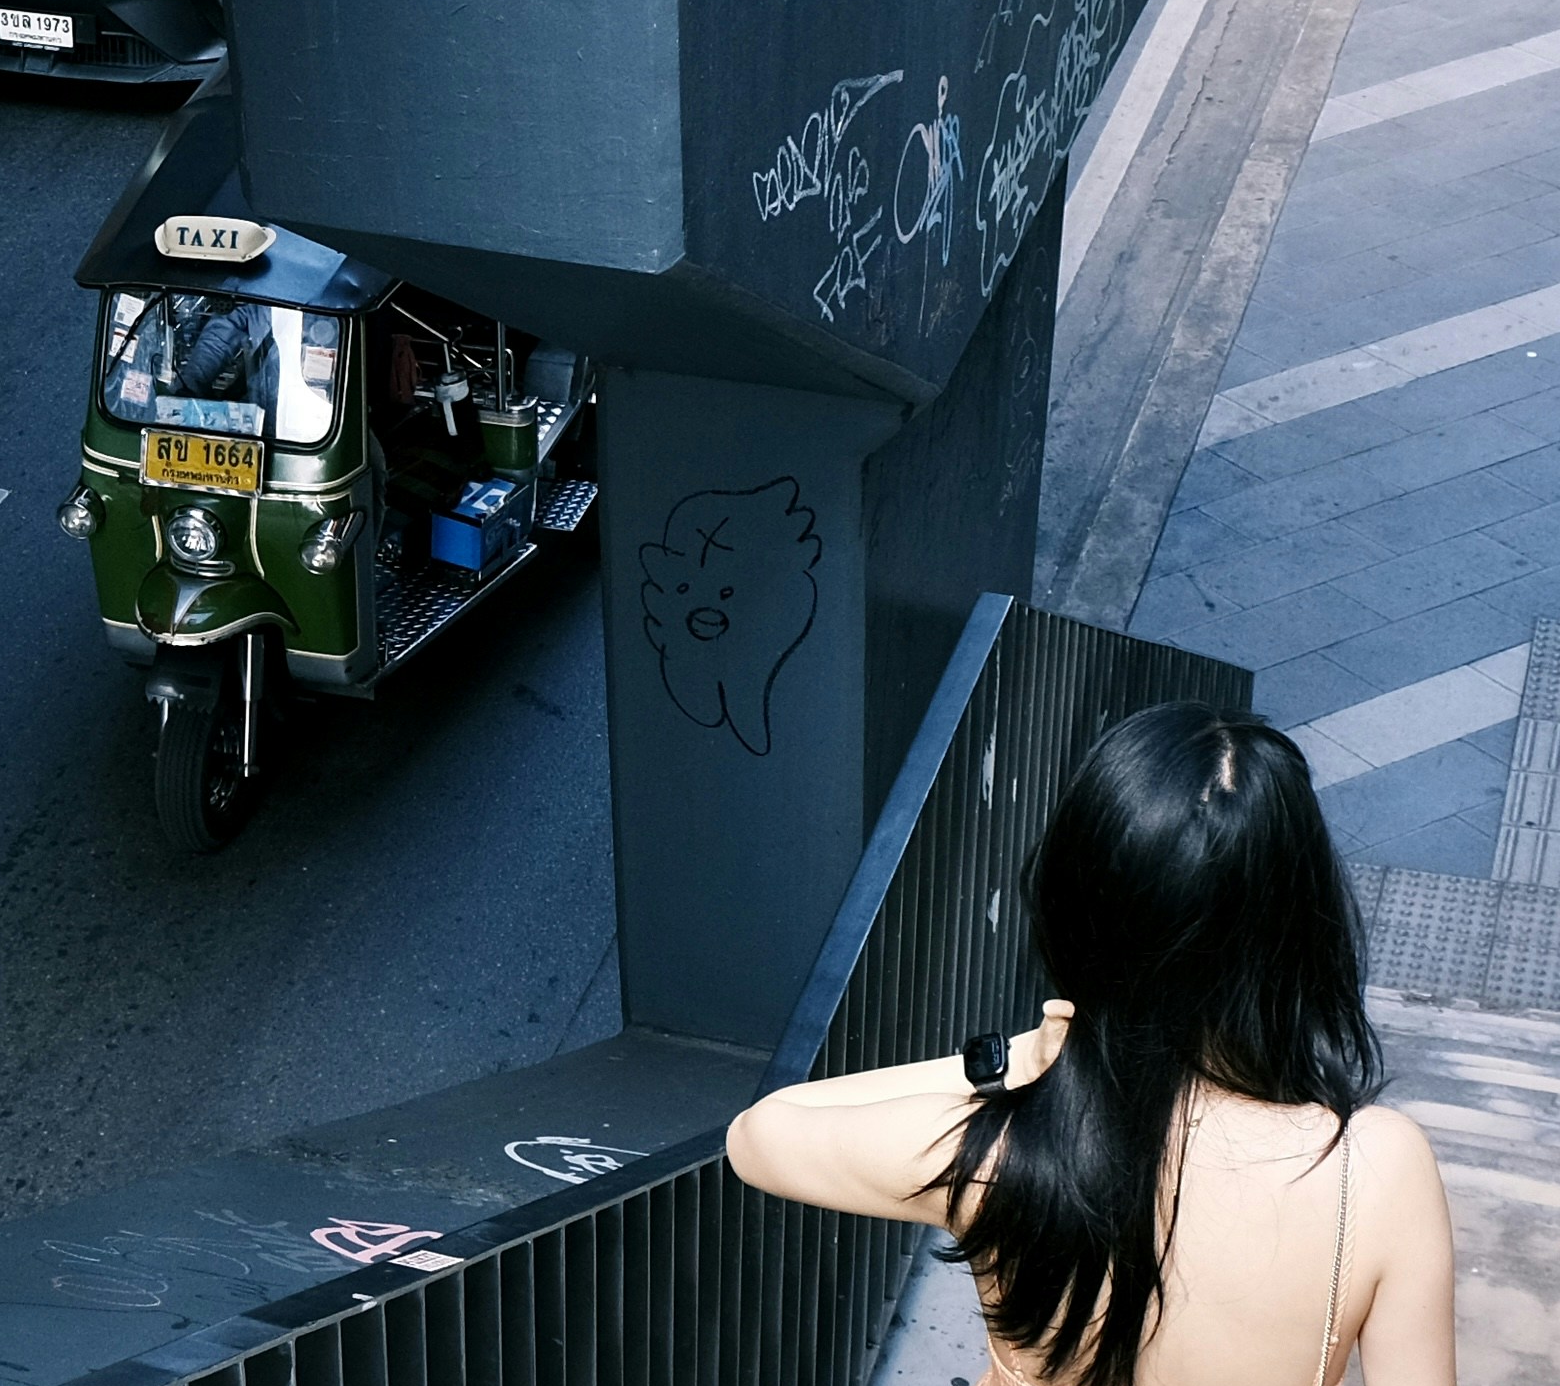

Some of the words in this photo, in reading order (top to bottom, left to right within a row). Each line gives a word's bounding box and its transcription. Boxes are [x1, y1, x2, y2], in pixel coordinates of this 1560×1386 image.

[37, 16, 70, 34] 1973
[176, 226, 239, 249] TAXI
[203, 443, 254, 469] 1664
